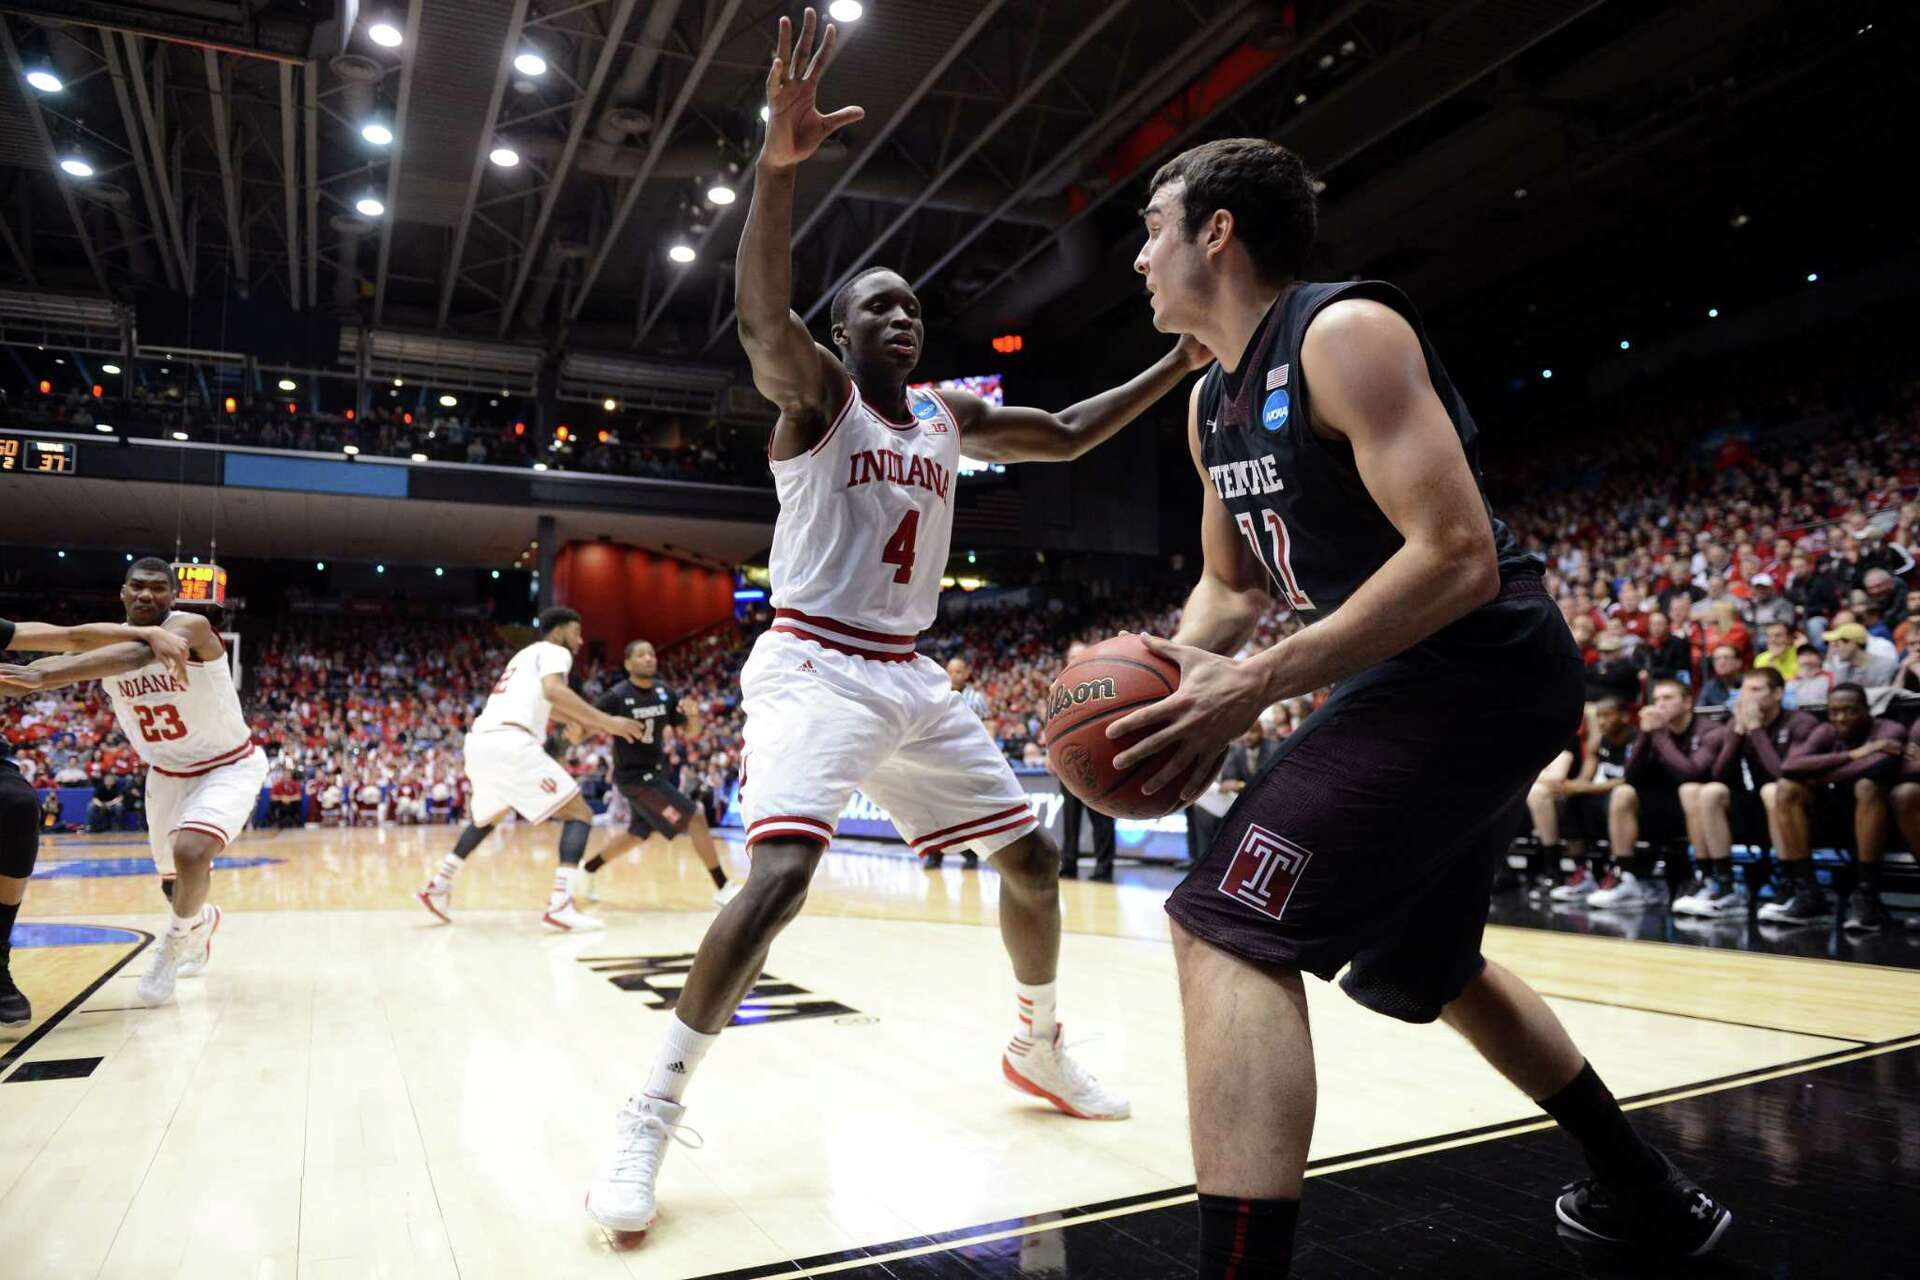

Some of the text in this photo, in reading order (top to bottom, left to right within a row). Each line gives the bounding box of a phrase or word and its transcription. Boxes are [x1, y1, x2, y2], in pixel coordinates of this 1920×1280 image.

[38, 453, 65, 472] 37
[847, 449, 950, 507] INDIANA
[881, 509, 920, 585] 4
[133, 703, 188, 743] 23
